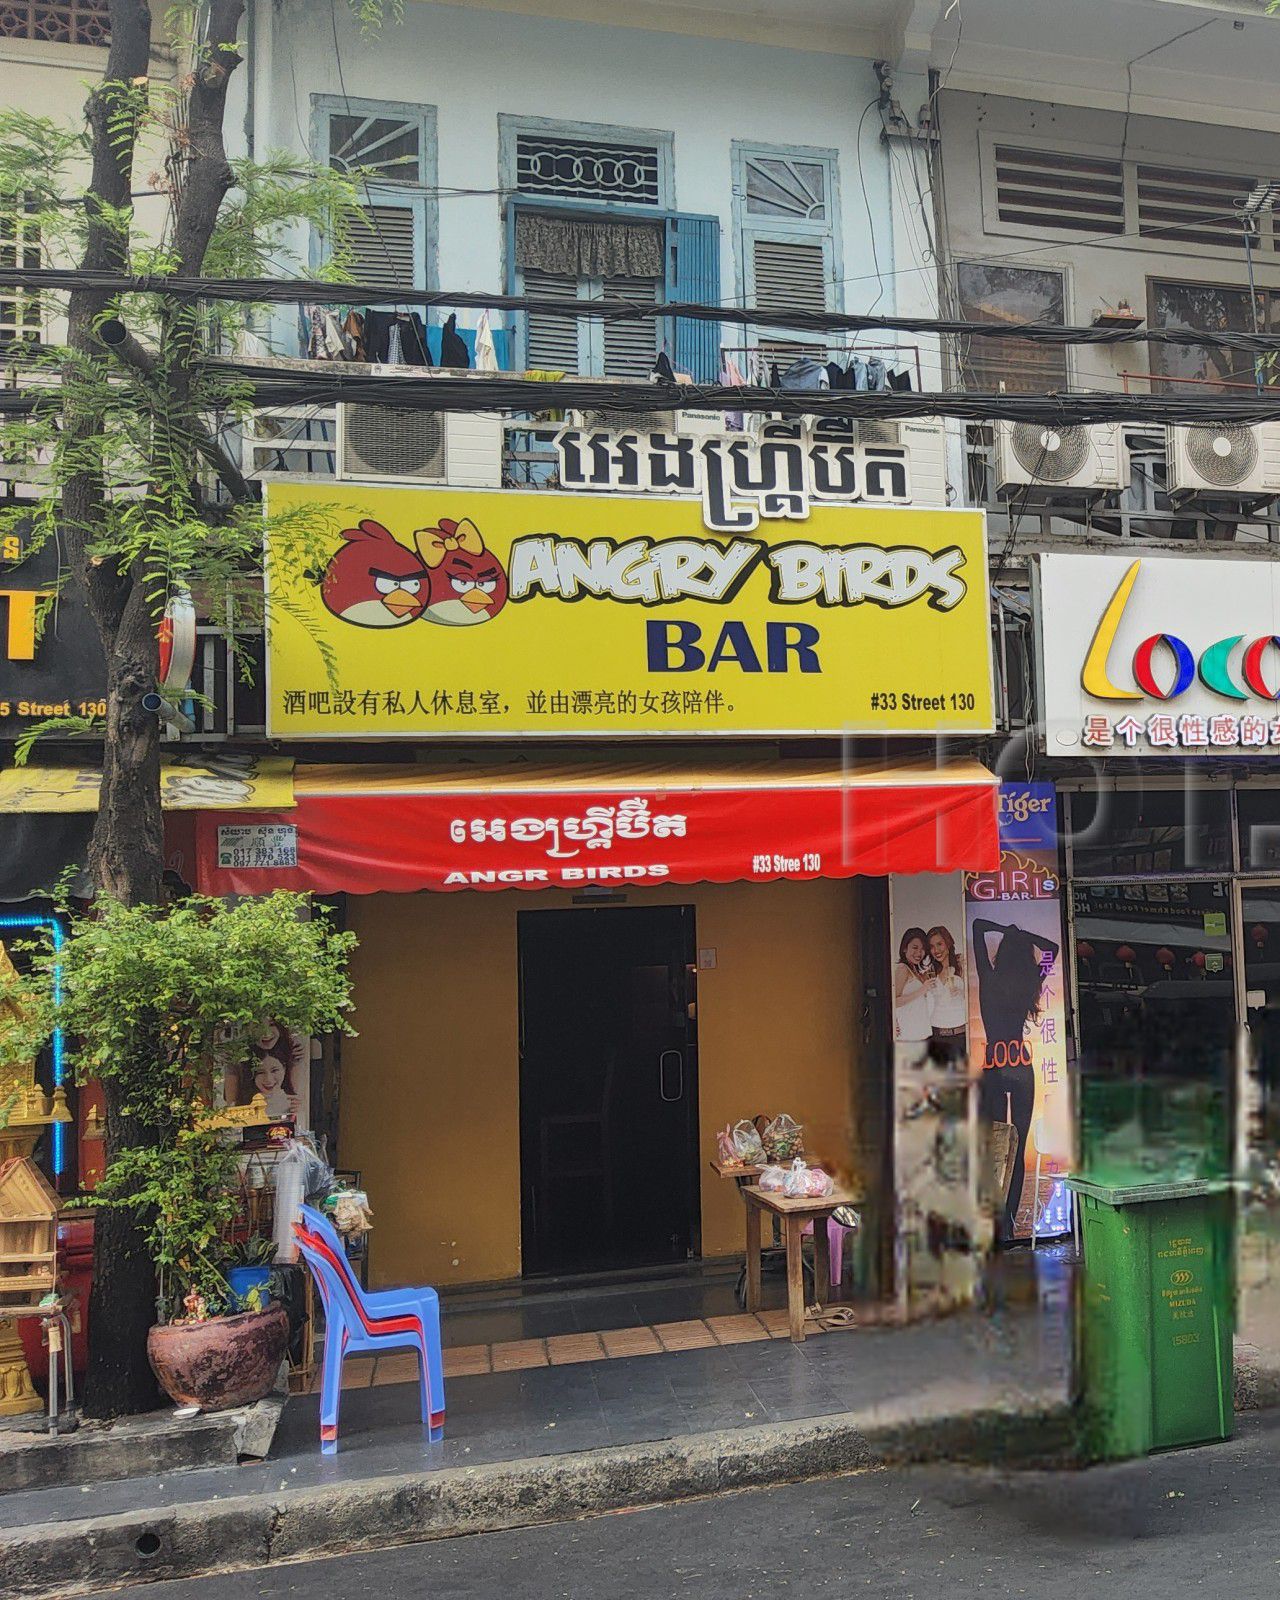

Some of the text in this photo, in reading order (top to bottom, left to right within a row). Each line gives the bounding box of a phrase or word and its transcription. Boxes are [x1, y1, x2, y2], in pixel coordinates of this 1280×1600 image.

[681, 411, 721, 421] Panasonic
[904, 425, 940, 435] Panasonic
[507, 534, 968, 613] ANGRY BIRDS
[646, 619, 823, 674] BAR
[18, 700, 70, 716] Street
[79, 701, 106, 716] 130
[870, 692, 976, 711] #33 Street 130
[752, 853, 821, 873] #33 Stree 130
[443, 864, 670, 885] ANGR BIRDS
[1001, 892, 1031, 901] BAR
[981, 1039, 1034, 1070] LOCO
